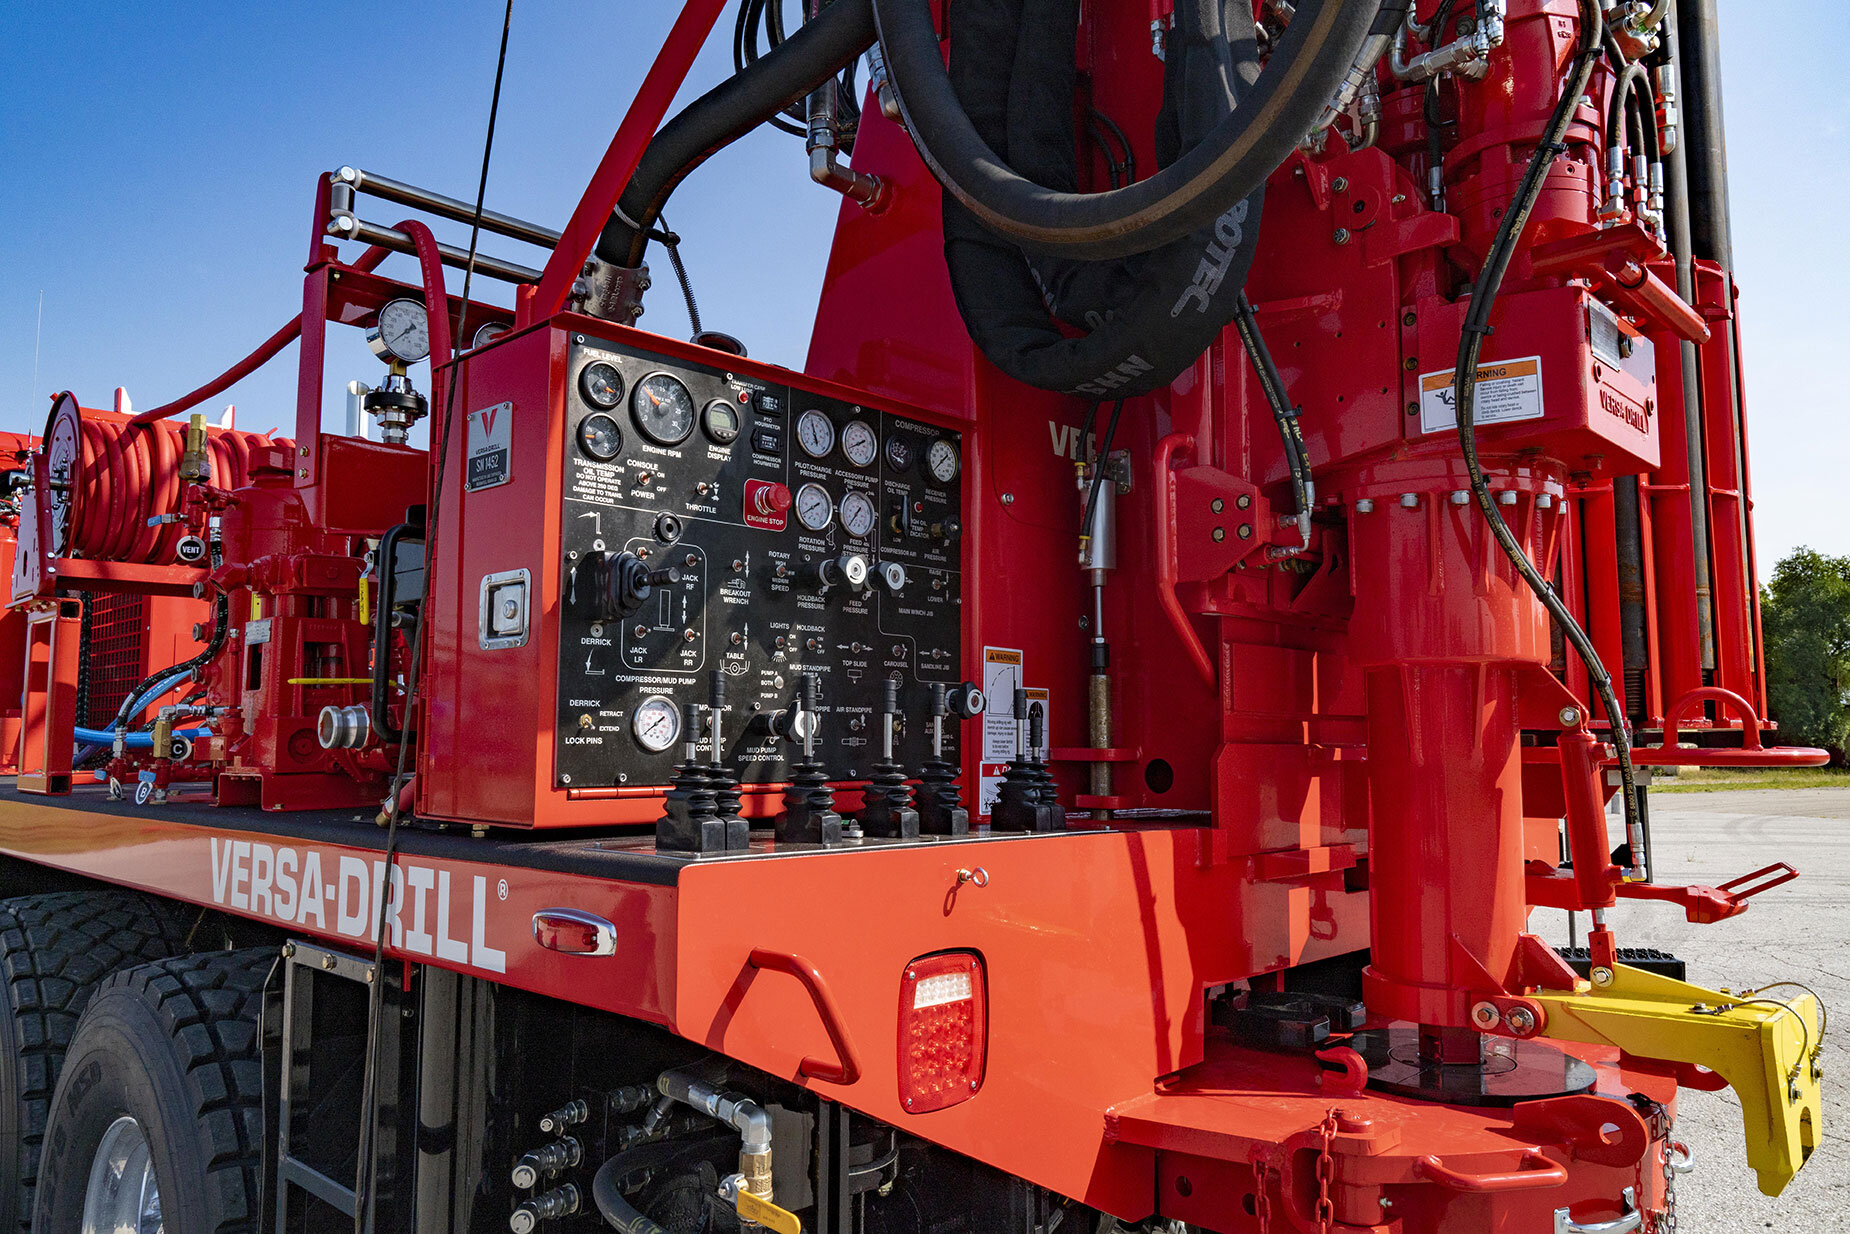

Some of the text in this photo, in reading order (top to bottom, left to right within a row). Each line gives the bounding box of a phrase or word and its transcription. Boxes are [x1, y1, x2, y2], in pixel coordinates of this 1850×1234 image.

[583, 348, 623, 364] FUEL LEVEL
[1476, 368, 1507, 379] RNING
[895, 419, 941, 437] COMPRESSOR
[642, 445, 683, 459] ENGINE RPM
[708, 445, 732, 455] ENGINE
[707, 451, 733, 463] DISPLAY
[573, 458, 626, 474] TRANSMISSION
[626, 458, 660, 471] CONSOLE
[583, 467, 616, 479] OIL TEMP
[799, 469, 828, 481] PRESSURE
[834, 469, 865, 482] ACCESSORY
[575, 472, 586, 480] DO
[597, 476, 622, 486] OPERATE
[579, 479, 598, 488] ABOVE
[843, 478, 870, 489] PRESSURE
[573, 486, 596, 496] DAMAGE
[596, 489, 604, 497] TO
[630, 489, 656, 500] POWER
[582, 493, 615, 505] CAN OCCUR
[684, 502, 718, 515] THROTTLE
[747, 515, 785, 527] ENGINE STOP
[798, 536, 827, 547] ROTATION
[849, 538, 863, 546] FEED
[182, 545, 200, 554] VENT
[798, 543, 827, 553] PRESSURE
[843, 544, 869, 554] PRESSURE
[768, 550, 791, 560] ROTARY
[681, 574, 699, 583] JACK
[685, 583, 695, 591] RF
[771, 584, 790, 592] SPEED
[719, 588, 752, 598] BREAKOUT
[723, 596, 750, 605] WRENCH
[796, 594, 827, 604] HOLDBACK
[849, 600, 863, 608] FEED
[797, 602, 826, 611] PRESSURE
[842, 606, 869, 616] PRESSURE
[769, 622, 790, 632] LIGHTS
[796, 624, 827, 634] HOLDBACK
[580, 637, 612, 647] DERRICK
[629, 646, 649, 655] JACK
[680, 649, 698, 658] JACK
[725, 651, 745, 660] TABLE
[634, 656, 644, 664] LR
[684, 658, 695, 667] RR
[995, 652, 1020, 663] WARNING
[788, 662, 832, 674] MUD STANDPIPE
[883, 661, 910, 669] CAROUSEL
[615, 675, 697, 686] COMPRESSOR/MUD PUMP
[760, 679, 775, 687] BOTH
[639, 686, 674, 696] PRESSURE
[569, 699, 602, 708] DERRICK
[599, 710, 624, 718] RETRACT
[565, 736, 604, 745] LOCK PINS
[172, 743, 184, 755] C
[746, 746, 760, 754] MUD
[738, 754, 785, 762] SPEED CONTROL
[139, 786, 148, 799] B
